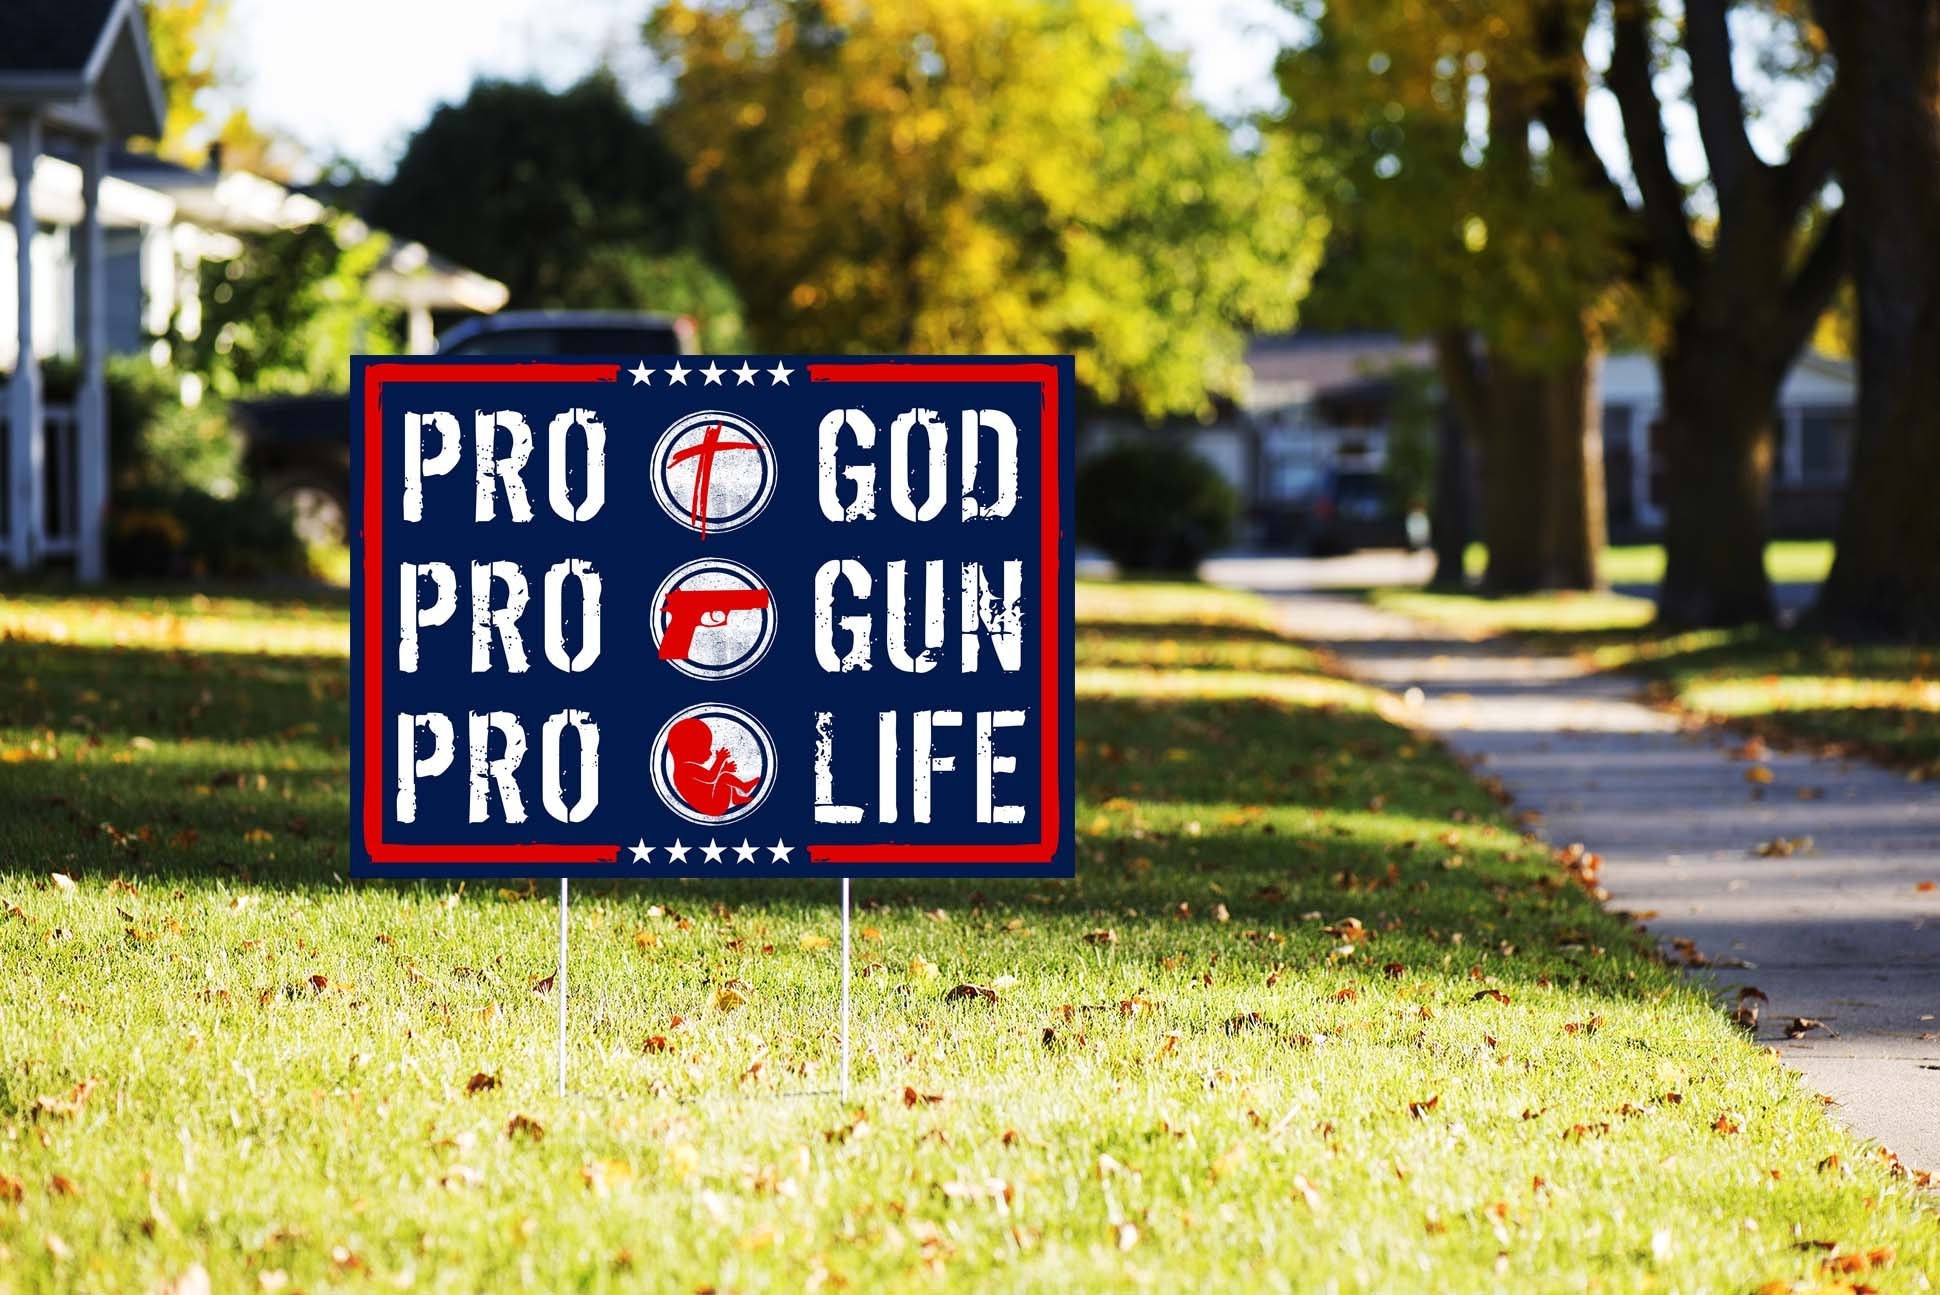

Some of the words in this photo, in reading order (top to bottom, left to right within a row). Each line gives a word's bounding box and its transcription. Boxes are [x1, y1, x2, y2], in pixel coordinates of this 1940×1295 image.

[404, 408, 606, 522] PRO
[819, 408, 1018, 522] GOD
[399, 559, 602, 673] PRO
[815, 559, 1024, 673] GUN
[397, 709, 599, 823] PRO
[815, 710, 1025, 823] LIFE
